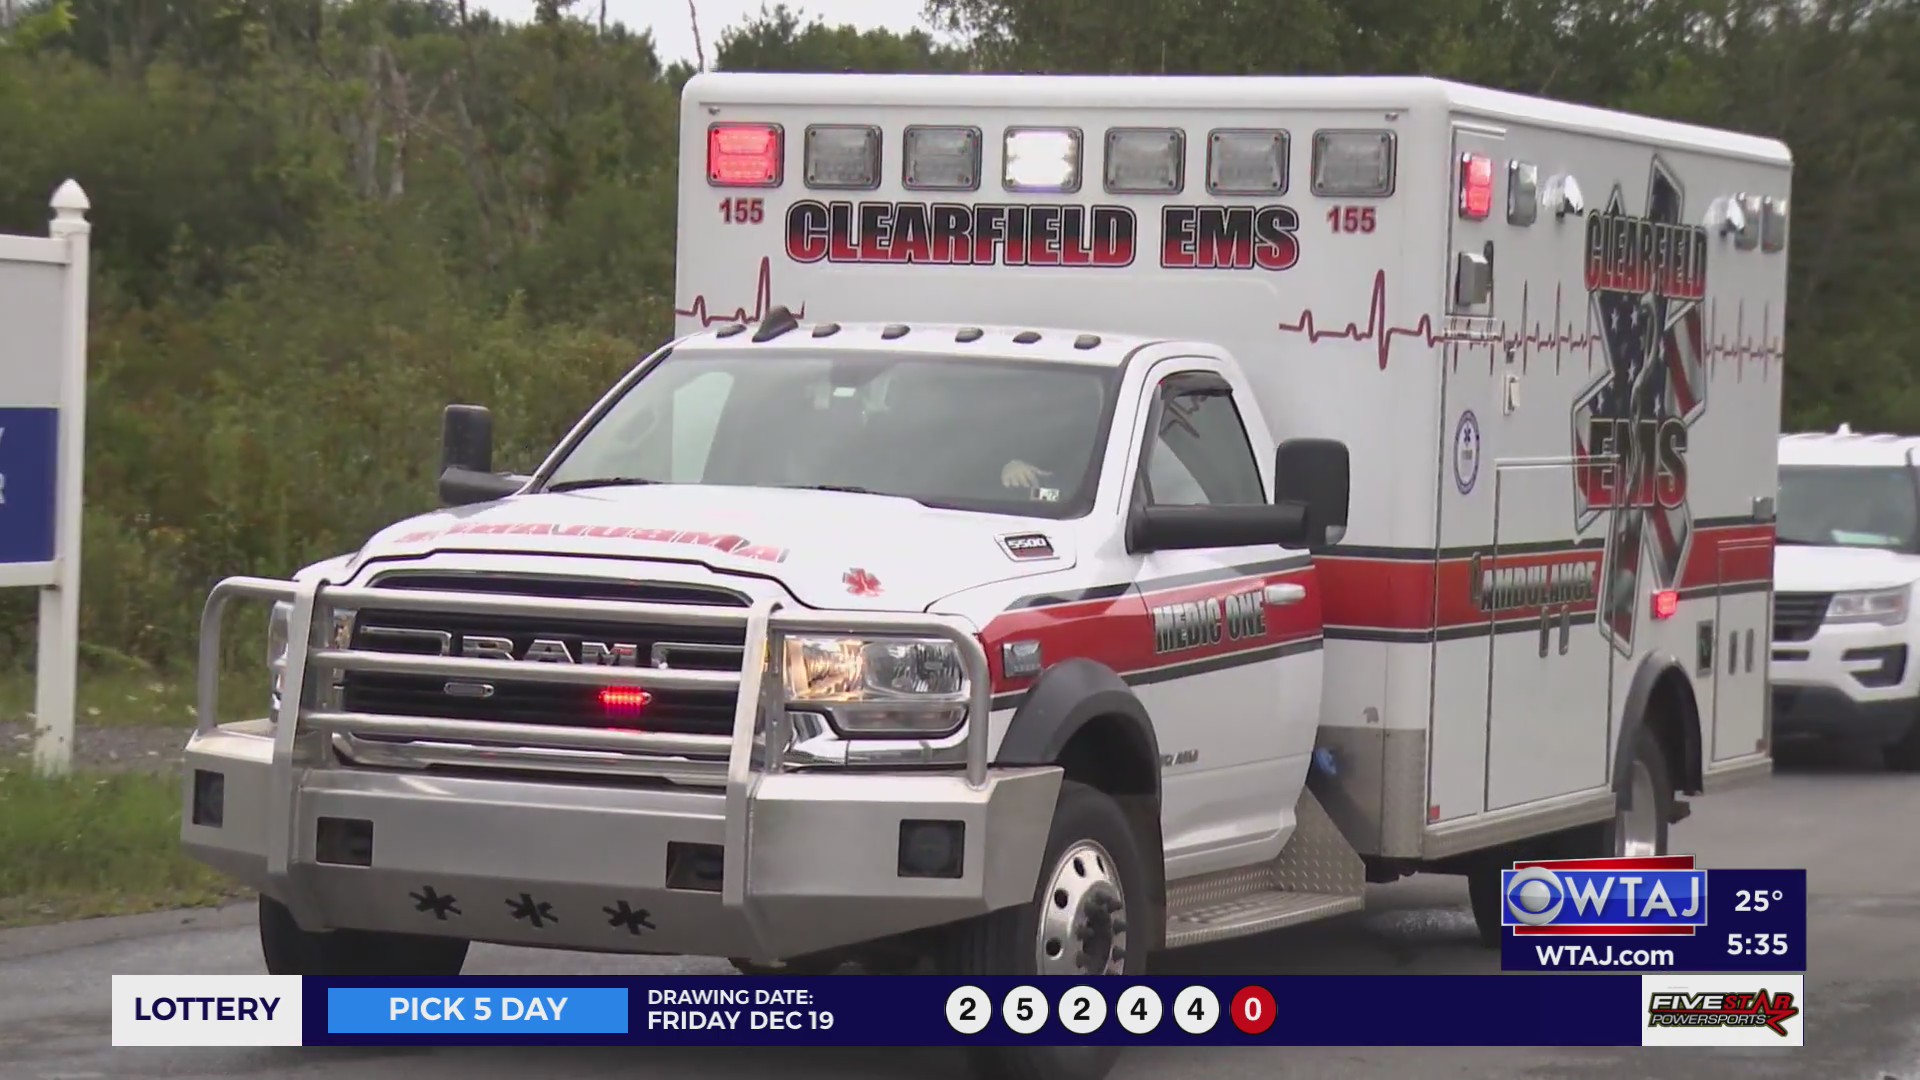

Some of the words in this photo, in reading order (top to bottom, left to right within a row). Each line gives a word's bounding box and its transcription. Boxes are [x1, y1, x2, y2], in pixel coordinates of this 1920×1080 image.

[719, 197, 765, 224] 155
[785, 200, 1137, 267] CLEARFIELD
[1160, 204, 1300, 271] EMS
[1326, 206, 1376, 234] 155
[1584, 209, 1708, 300] CLEARFIELD
[1587, 417, 1688, 509] EMS
[1007, 537, 1048, 549] 5500
[1481, 561, 1597, 613] AMBULANCE
[1153, 598, 1222, 654] MEDIC
[1225, 589, 1266, 641] ONE
[462, 635, 638, 667] RAM
